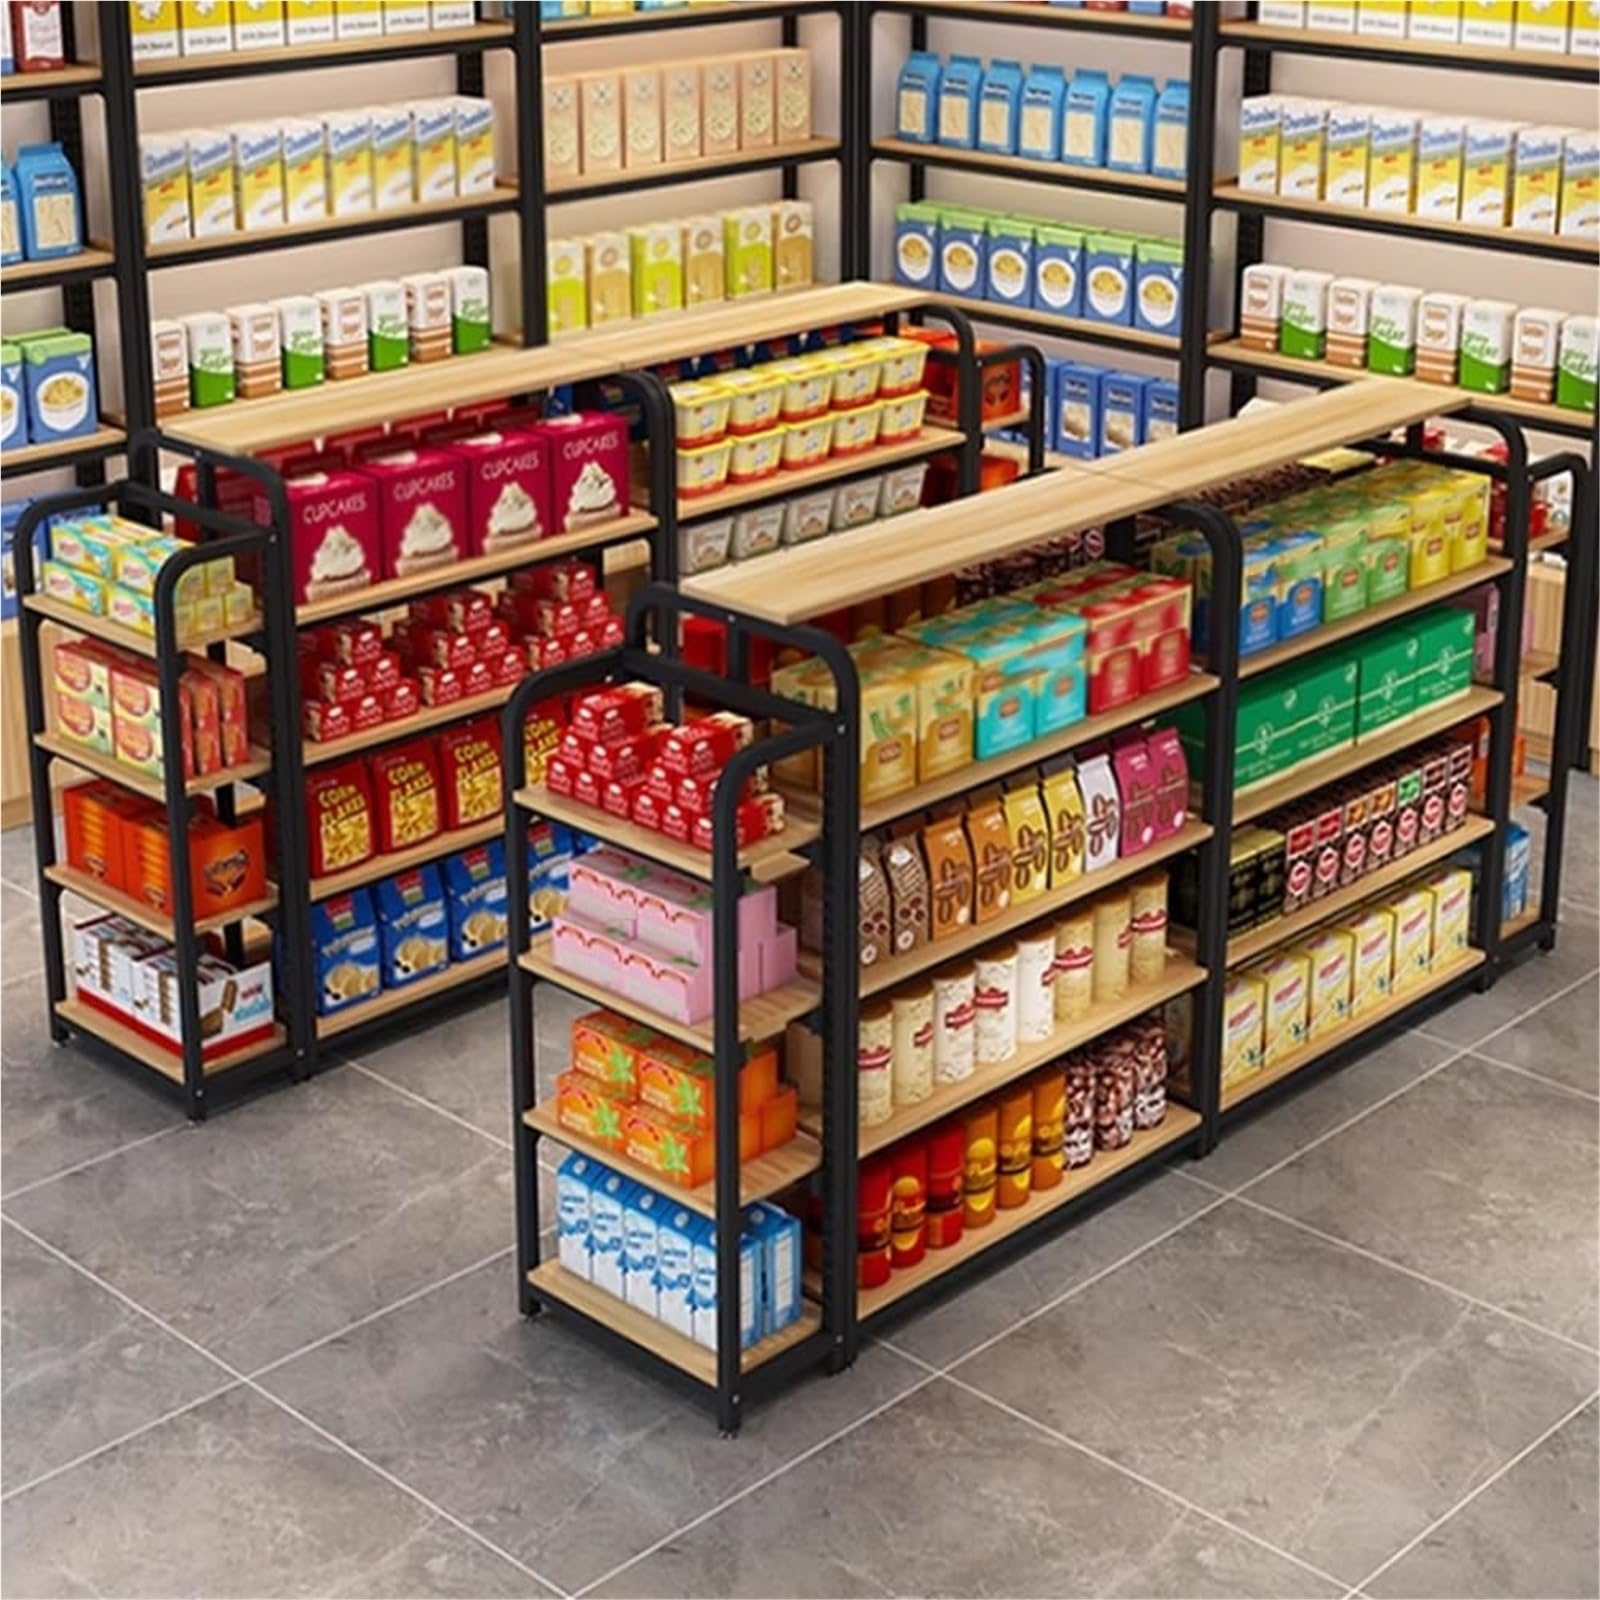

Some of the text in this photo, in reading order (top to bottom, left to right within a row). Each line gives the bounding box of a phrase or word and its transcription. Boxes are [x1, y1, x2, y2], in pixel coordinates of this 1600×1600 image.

[563, 431, 619, 461] CUPCAKES
[481, 451, 539, 480] CUPCAKES
[393, 471, 455, 501] CUPCAKES
[303, 492, 367, 524] CUPCAKES
[454, 741, 490, 763] CORN
[387, 762, 425, 785] CORN
[319, 784, 357, 808] CORN
